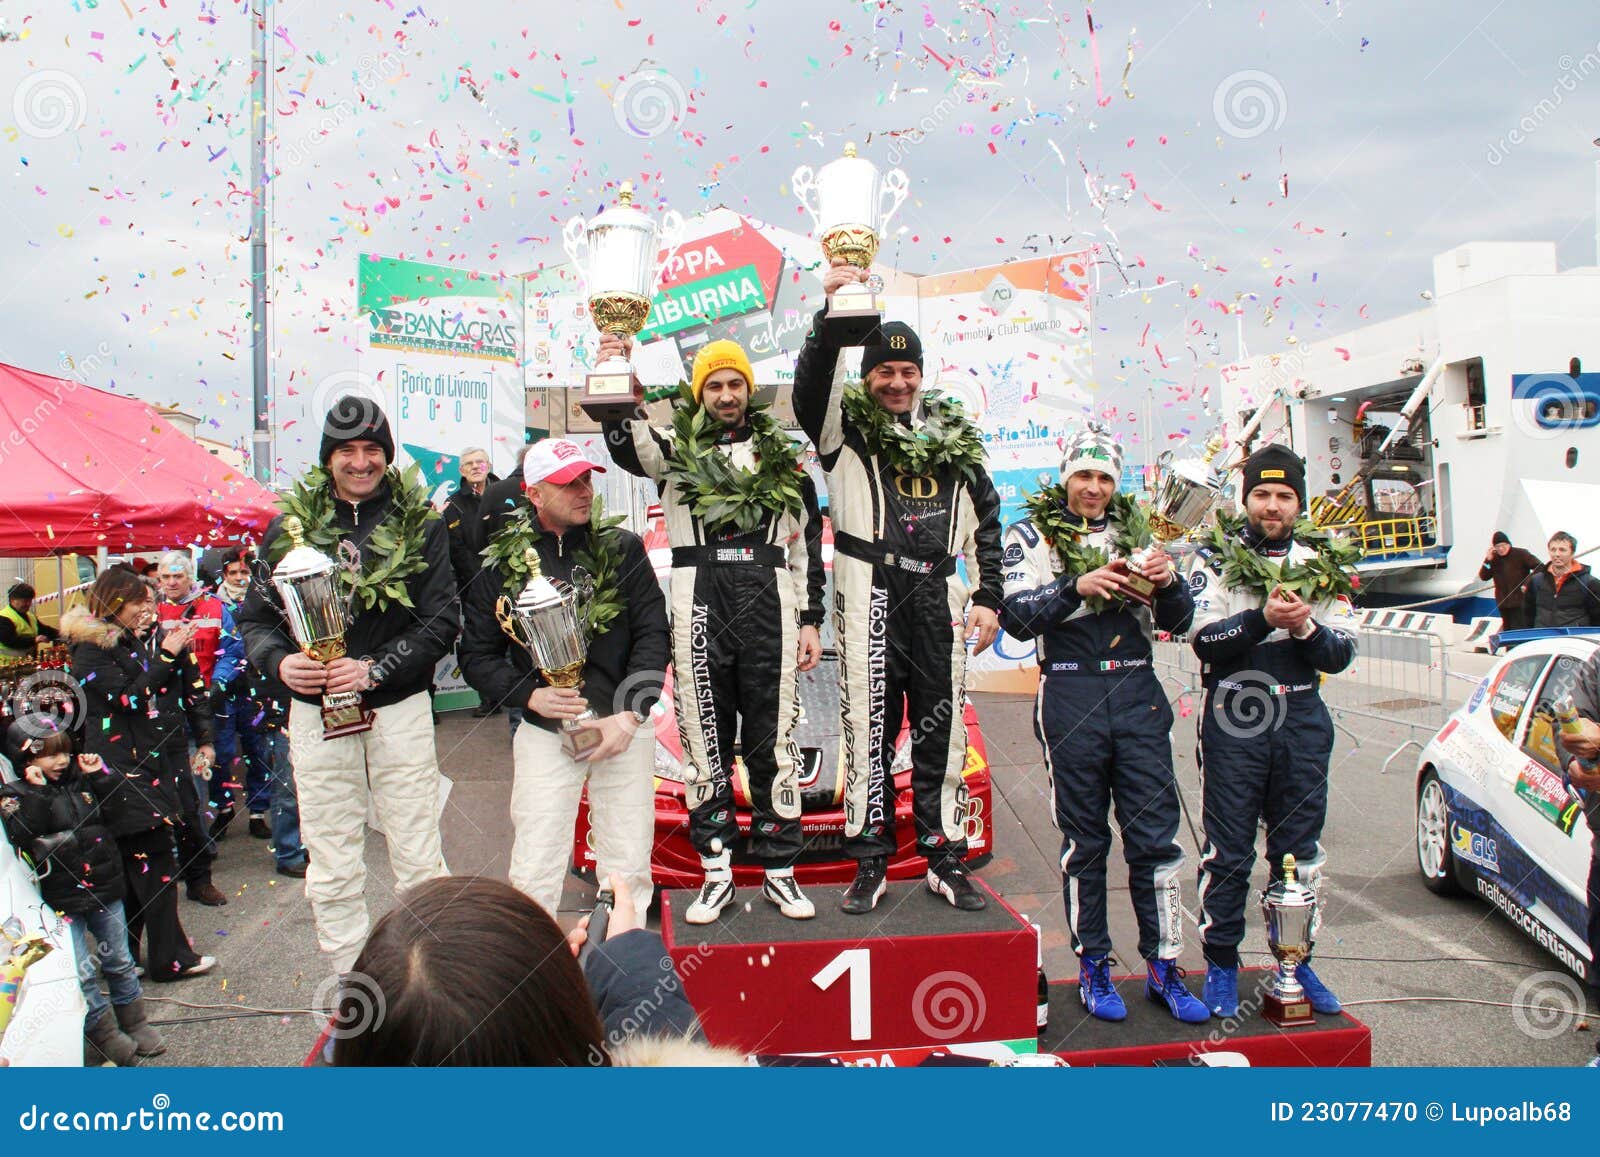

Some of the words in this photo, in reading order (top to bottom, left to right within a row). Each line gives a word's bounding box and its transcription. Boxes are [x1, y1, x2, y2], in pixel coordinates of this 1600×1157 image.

[998, 321, 1020, 336] Club
[435, 373, 445, 396] di
[447, 375, 487, 400] Livorno
[1562, 802, 1579, 833] 4
[1471, 832, 1498, 863] GLS
[811, 949, 871, 1041] 1
